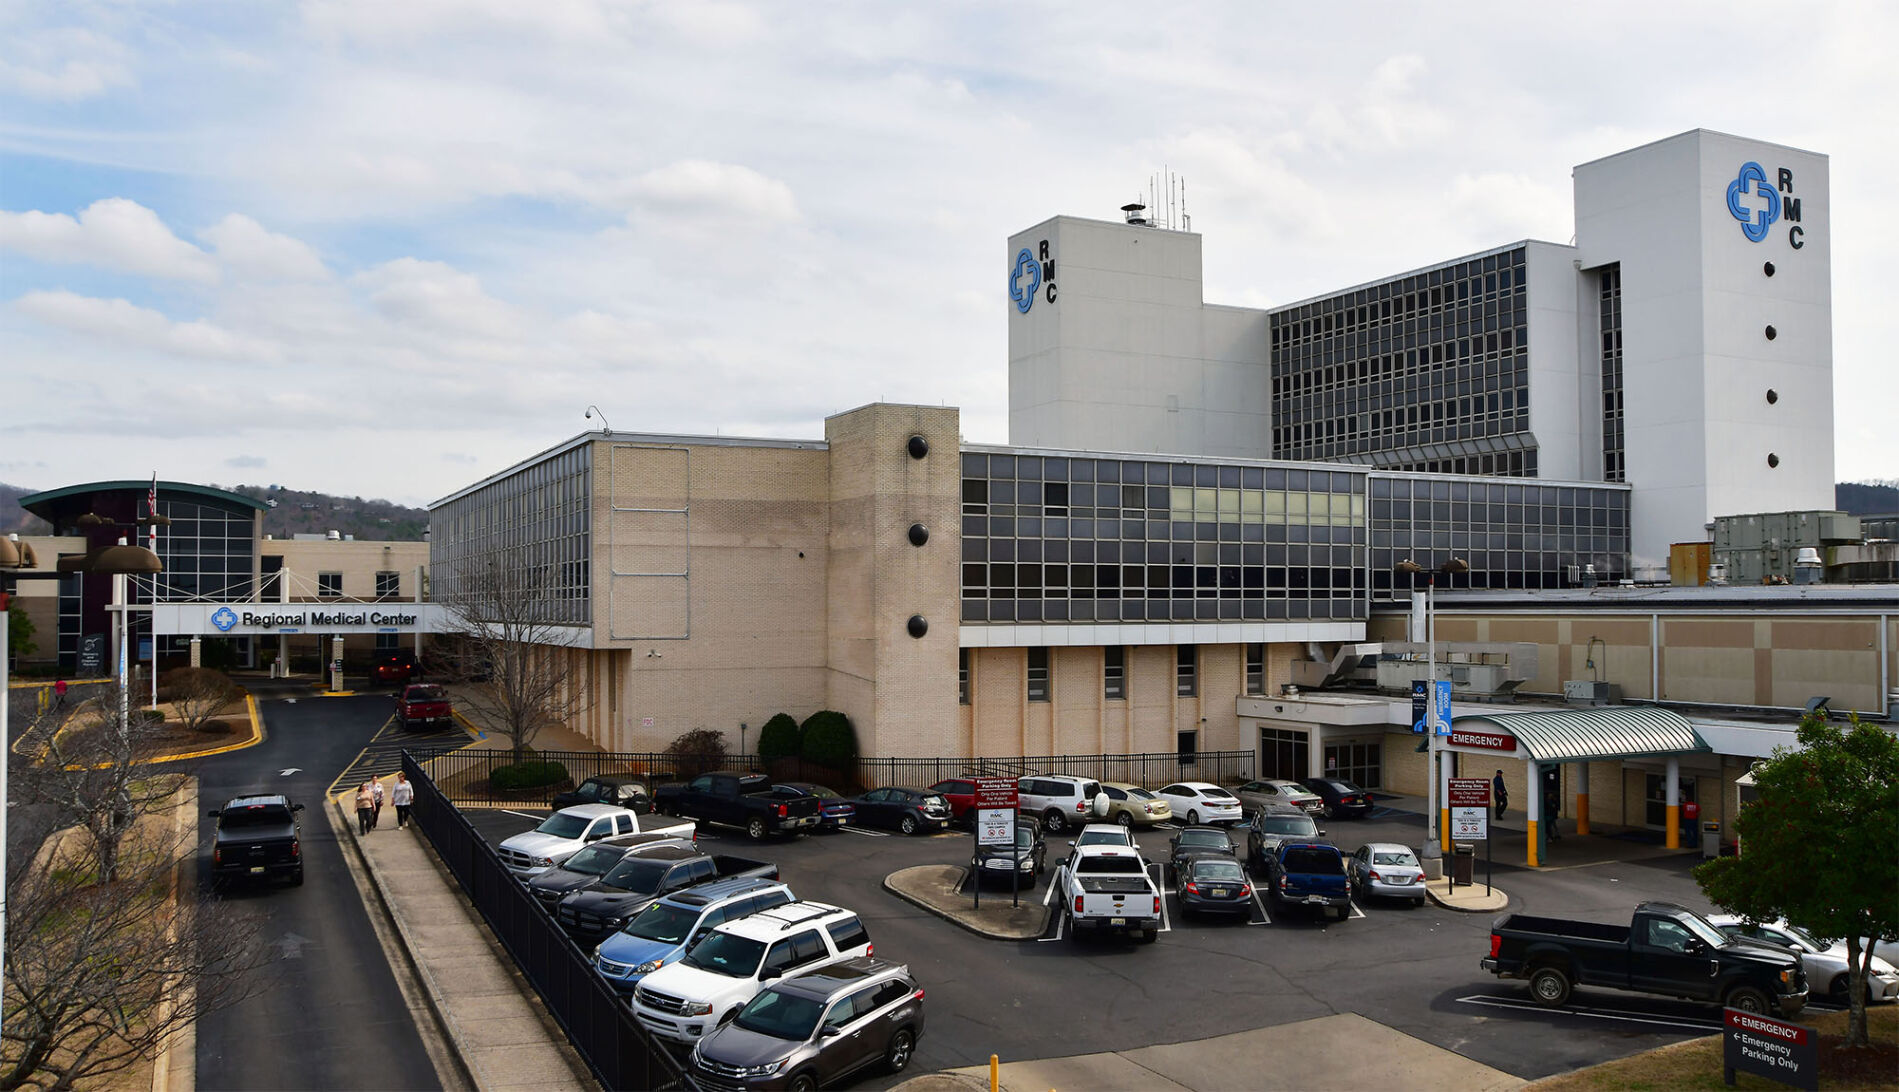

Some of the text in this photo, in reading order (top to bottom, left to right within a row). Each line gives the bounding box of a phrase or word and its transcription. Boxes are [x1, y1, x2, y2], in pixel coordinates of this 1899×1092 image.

[1778, 167, 1804, 250] RMC
[1039, 239, 1057, 304] RMC
[243, 612, 416, 628] Regional Medical Center
[1452, 733, 1504, 747] EMERGENCY
[1741, 1017, 1798, 1039] EMERGENCY
[1742, 1034, 1791, 1056] Emergency
[1742, 1046, 1799, 1072] Parking Only
